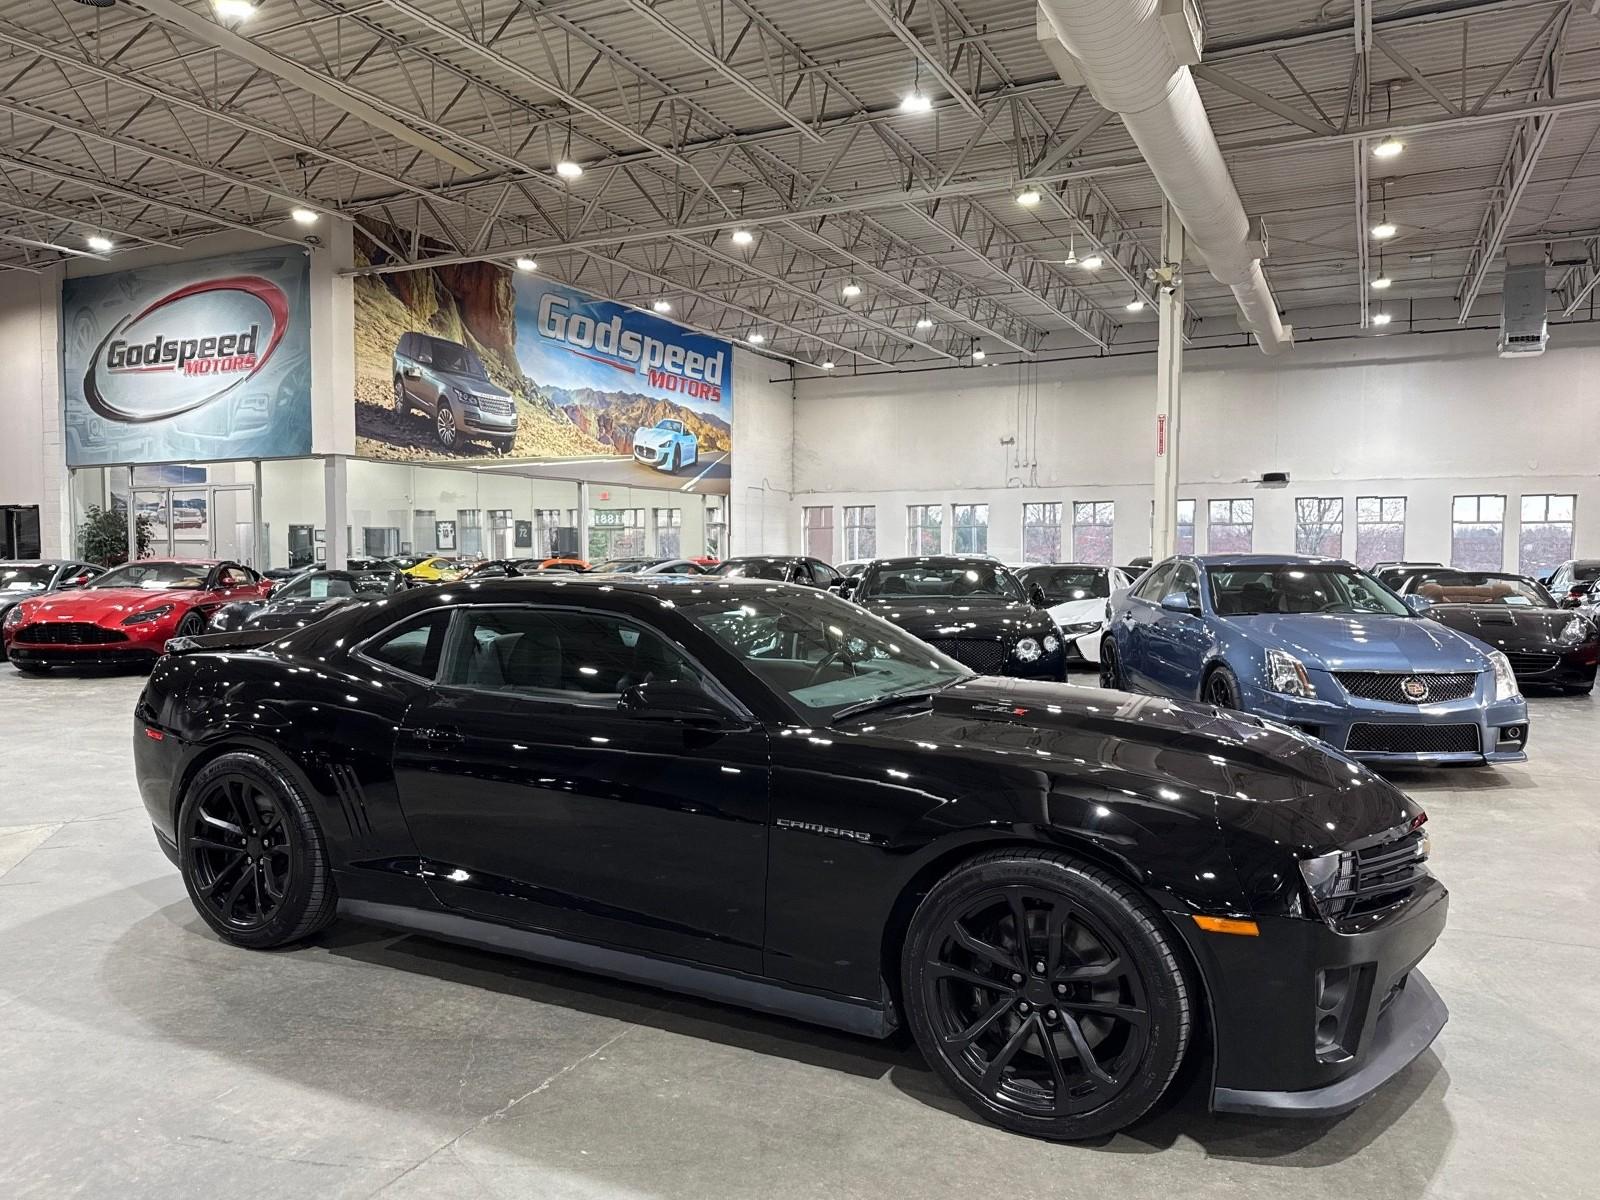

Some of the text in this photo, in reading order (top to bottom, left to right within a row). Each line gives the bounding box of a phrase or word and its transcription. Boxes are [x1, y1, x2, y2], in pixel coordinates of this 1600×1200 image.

[106, 324, 260, 369] Godspeed
[538, 292, 725, 386] Godspeed
[184, 355, 257, 376] MOTORS
[647, 367, 721, 401] MOTORS
[776, 817, 871, 841] CAMARO
